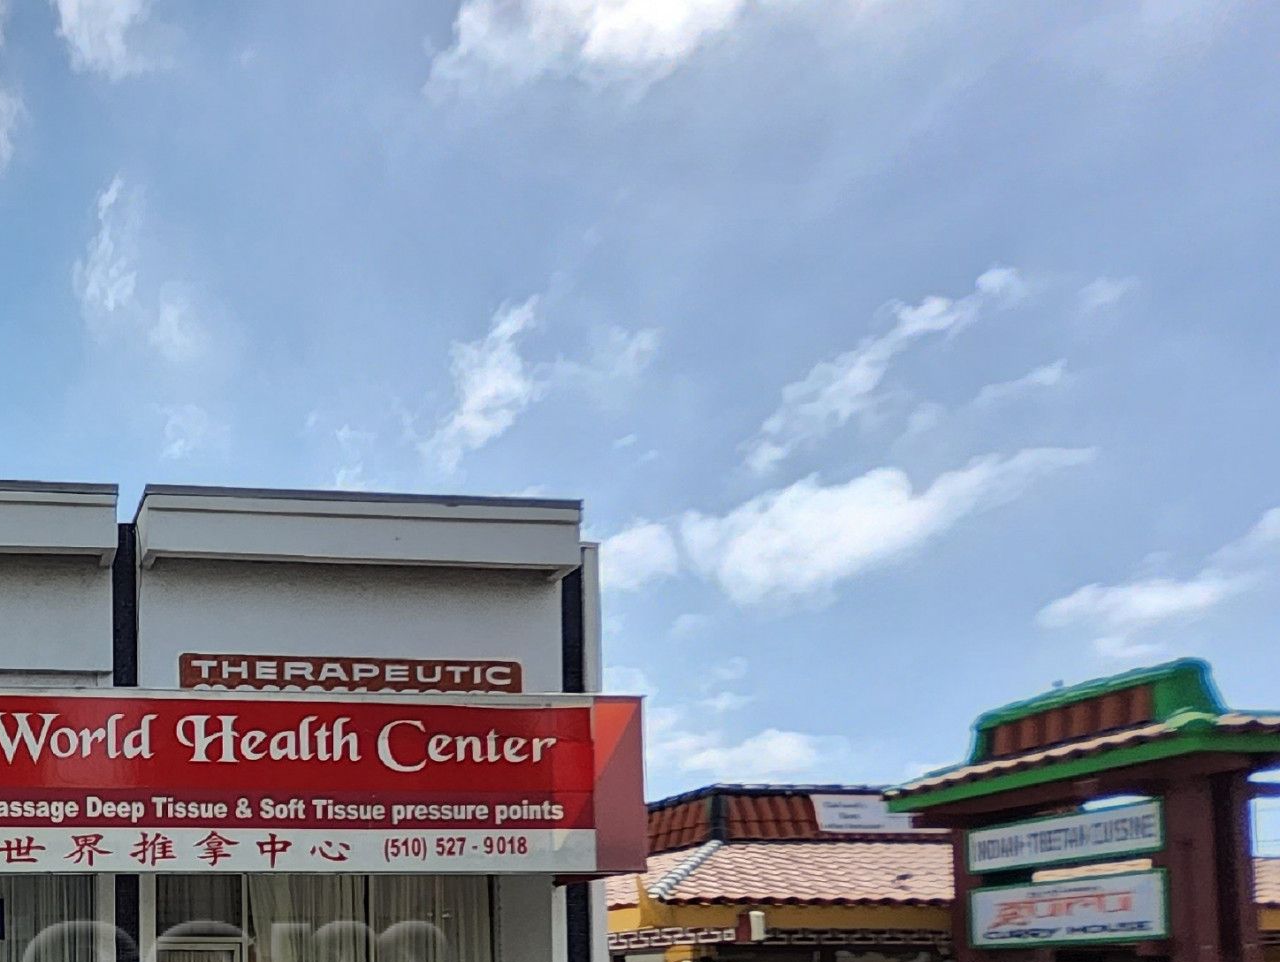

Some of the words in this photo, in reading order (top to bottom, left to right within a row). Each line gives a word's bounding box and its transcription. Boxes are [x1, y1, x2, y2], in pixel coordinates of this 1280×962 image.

[191, 660, 513, 685] THERAPEUTIC
[176, 714, 363, 764] Health
[376, 719, 558, 774] Center
[86, 797, 145, 823] Deep
[151, 797, 228, 819] Tissue
[235, 798, 253, 818] &
[260, 798, 306, 820] Soft
[312, 799, 386, 820] Tissue
[391, 803, 489, 825] pressure
[495, 800, 565, 824] points
[383, 837, 428, 861] (510)
